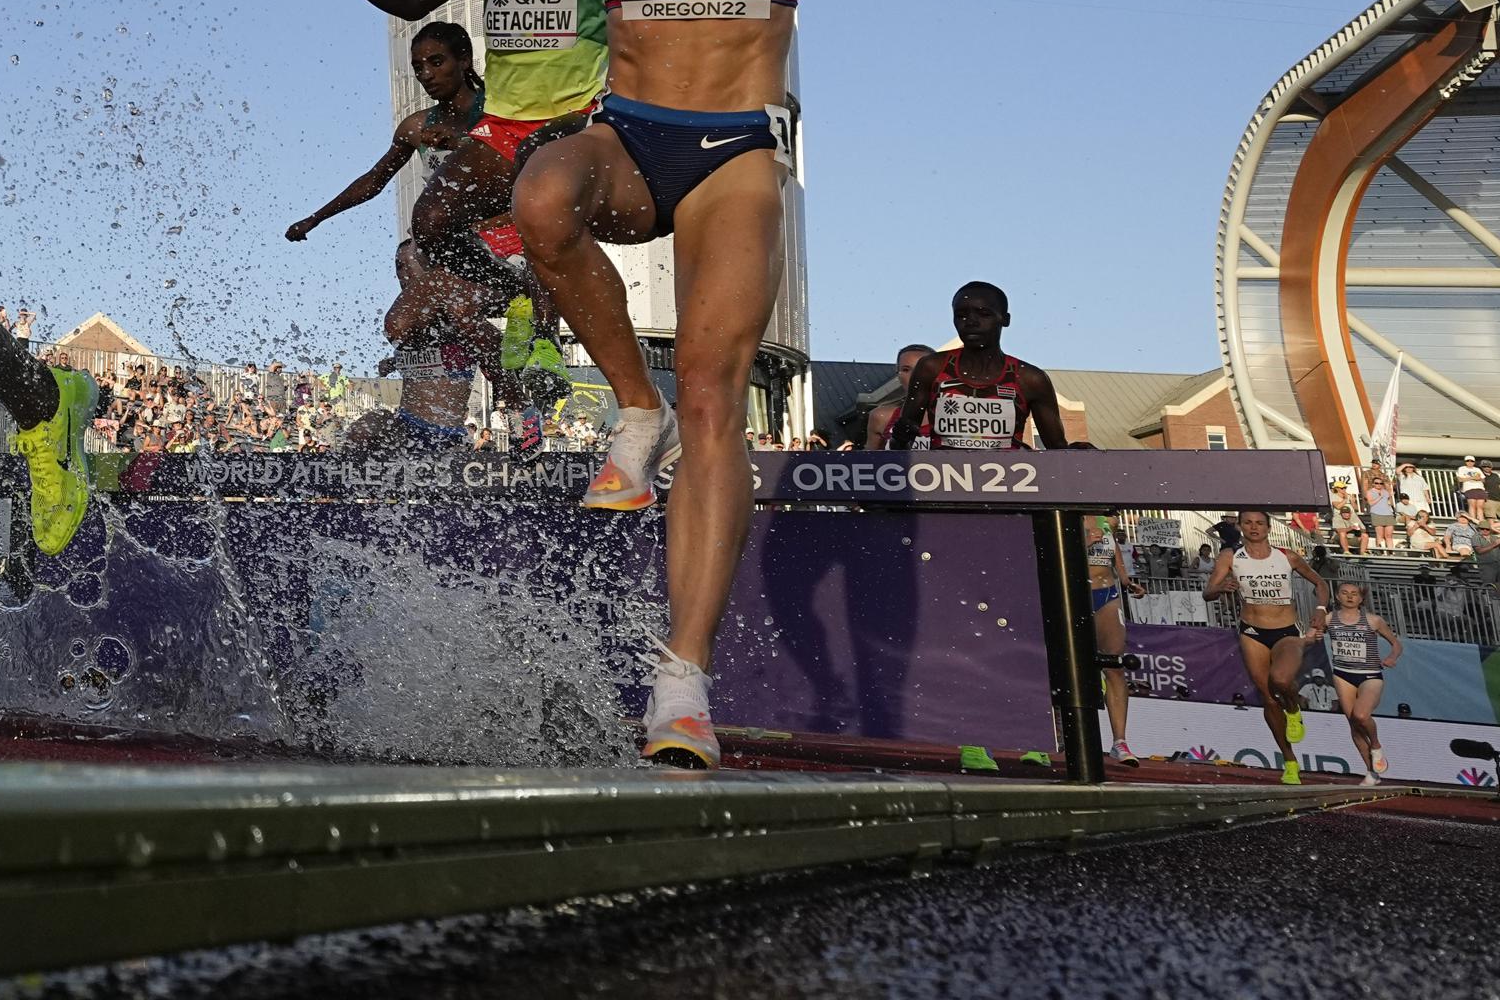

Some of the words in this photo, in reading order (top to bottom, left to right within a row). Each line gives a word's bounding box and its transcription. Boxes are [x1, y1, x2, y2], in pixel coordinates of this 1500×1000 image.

[642, 1, 747, 17] OREGON22
[486, 10, 572, 31] GETACHEW
[492, 38, 559, 49] OREGON22
[963, 401, 1003, 415] QNB
[938, 417, 1011, 435] CHESPOL
[947, 439, 1002, 448] OREGON22
[184, 460, 283, 485] WORLD
[289, 460, 452, 487] ATHLETICS
[1252, 589, 1281, 598] FINOT
[1343, 641, 1361, 649] QNB
[1337, 648, 1361, 657] PRATT
